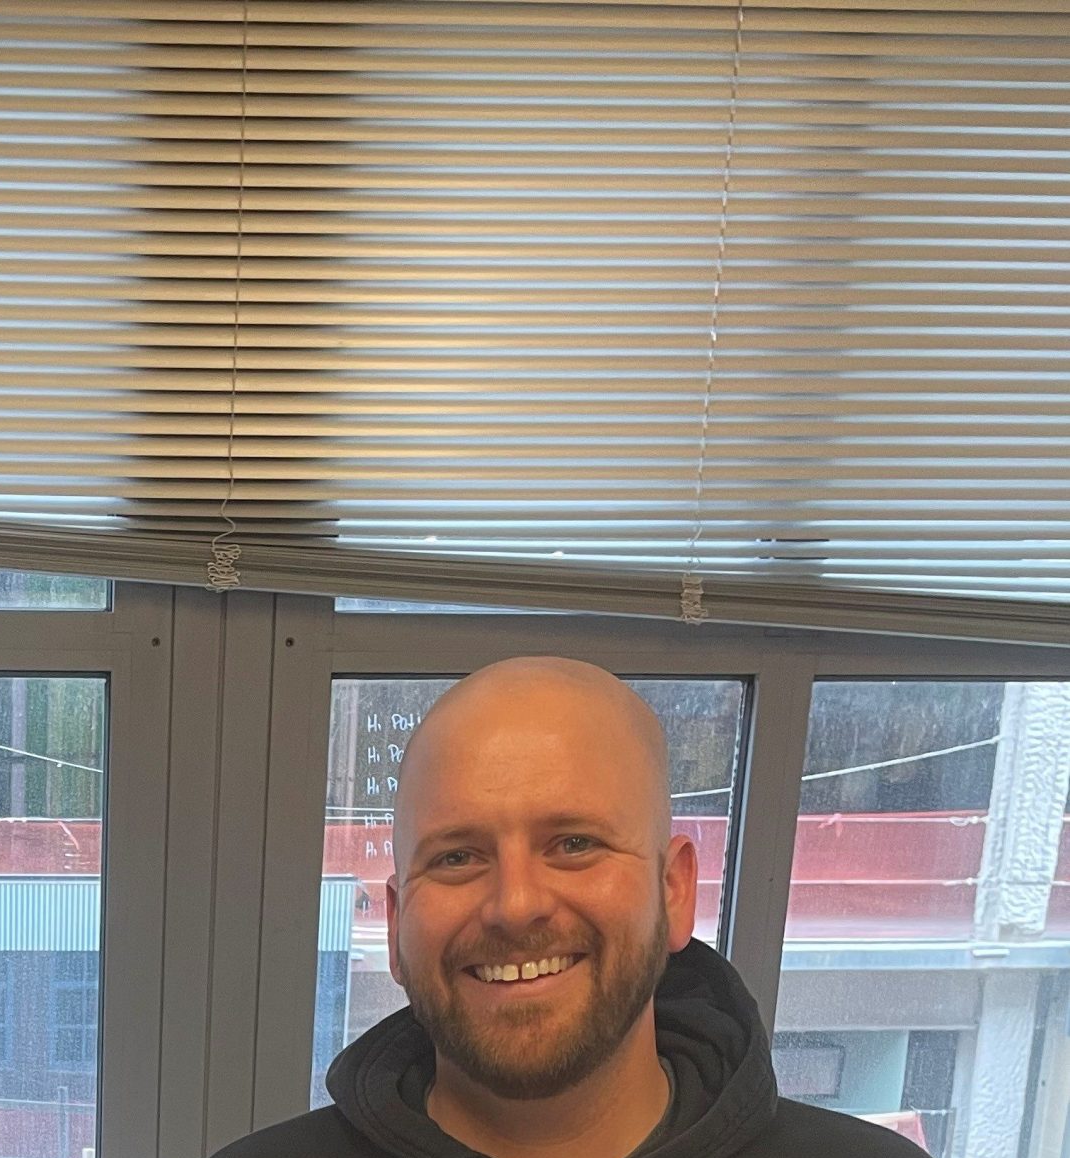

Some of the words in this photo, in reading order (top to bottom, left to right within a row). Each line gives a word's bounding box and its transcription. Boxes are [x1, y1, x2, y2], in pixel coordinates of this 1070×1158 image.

[367, 713, 382, 733] Hi
[368, 746, 380, 764] Hi
[367, 776, 380, 795] Hi
[365, 841, 378, 859] Hi
